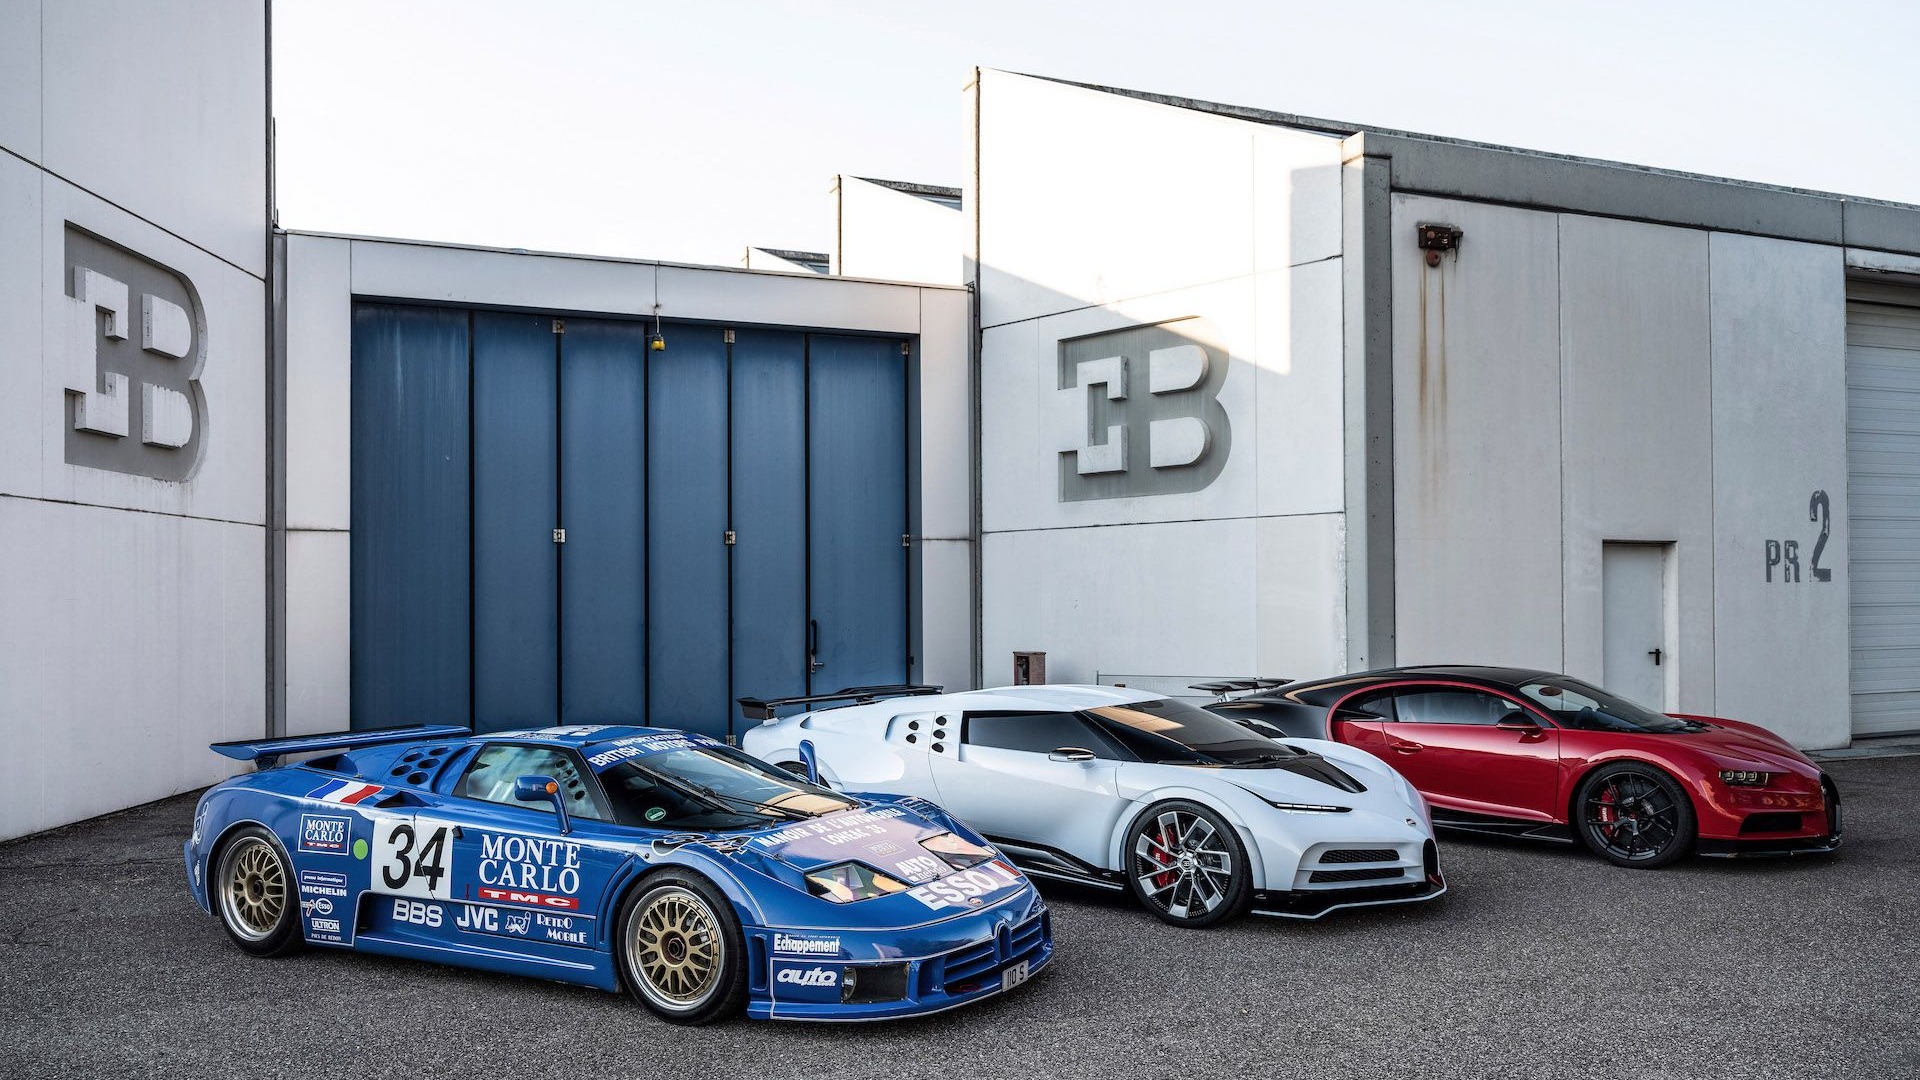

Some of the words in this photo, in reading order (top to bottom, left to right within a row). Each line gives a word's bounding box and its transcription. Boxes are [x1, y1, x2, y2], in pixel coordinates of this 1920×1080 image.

[1765, 540, 1800, 583] PR
[1809, 490, 1831, 583] 2
[588, 745, 645, 767] BRITISH
[642, 739, 697, 751] MOTORS
[305, 830, 343, 842] CARLO
[306, 819, 344, 832] MONTE
[754, 828, 813, 847] MANOIR
[809, 822, 831, 834] DE
[382, 824, 447, 891] 34
[480, 834, 581, 869] MONTE
[478, 859, 580, 895] CARLO
[895, 856, 938, 876] AUTO
[301, 885, 347, 897] MICHELIN
[483, 890, 571, 906] TMC
[905, 870, 999, 911] ESSO
[392, 899, 443, 928] BBS
[456, 905, 499, 932] JVC
[311, 920, 340, 931] ULTRON
[774, 933, 840, 955] Echappement
[777, 966, 838, 984] auto
[1019, 964, 1025, 981] S
